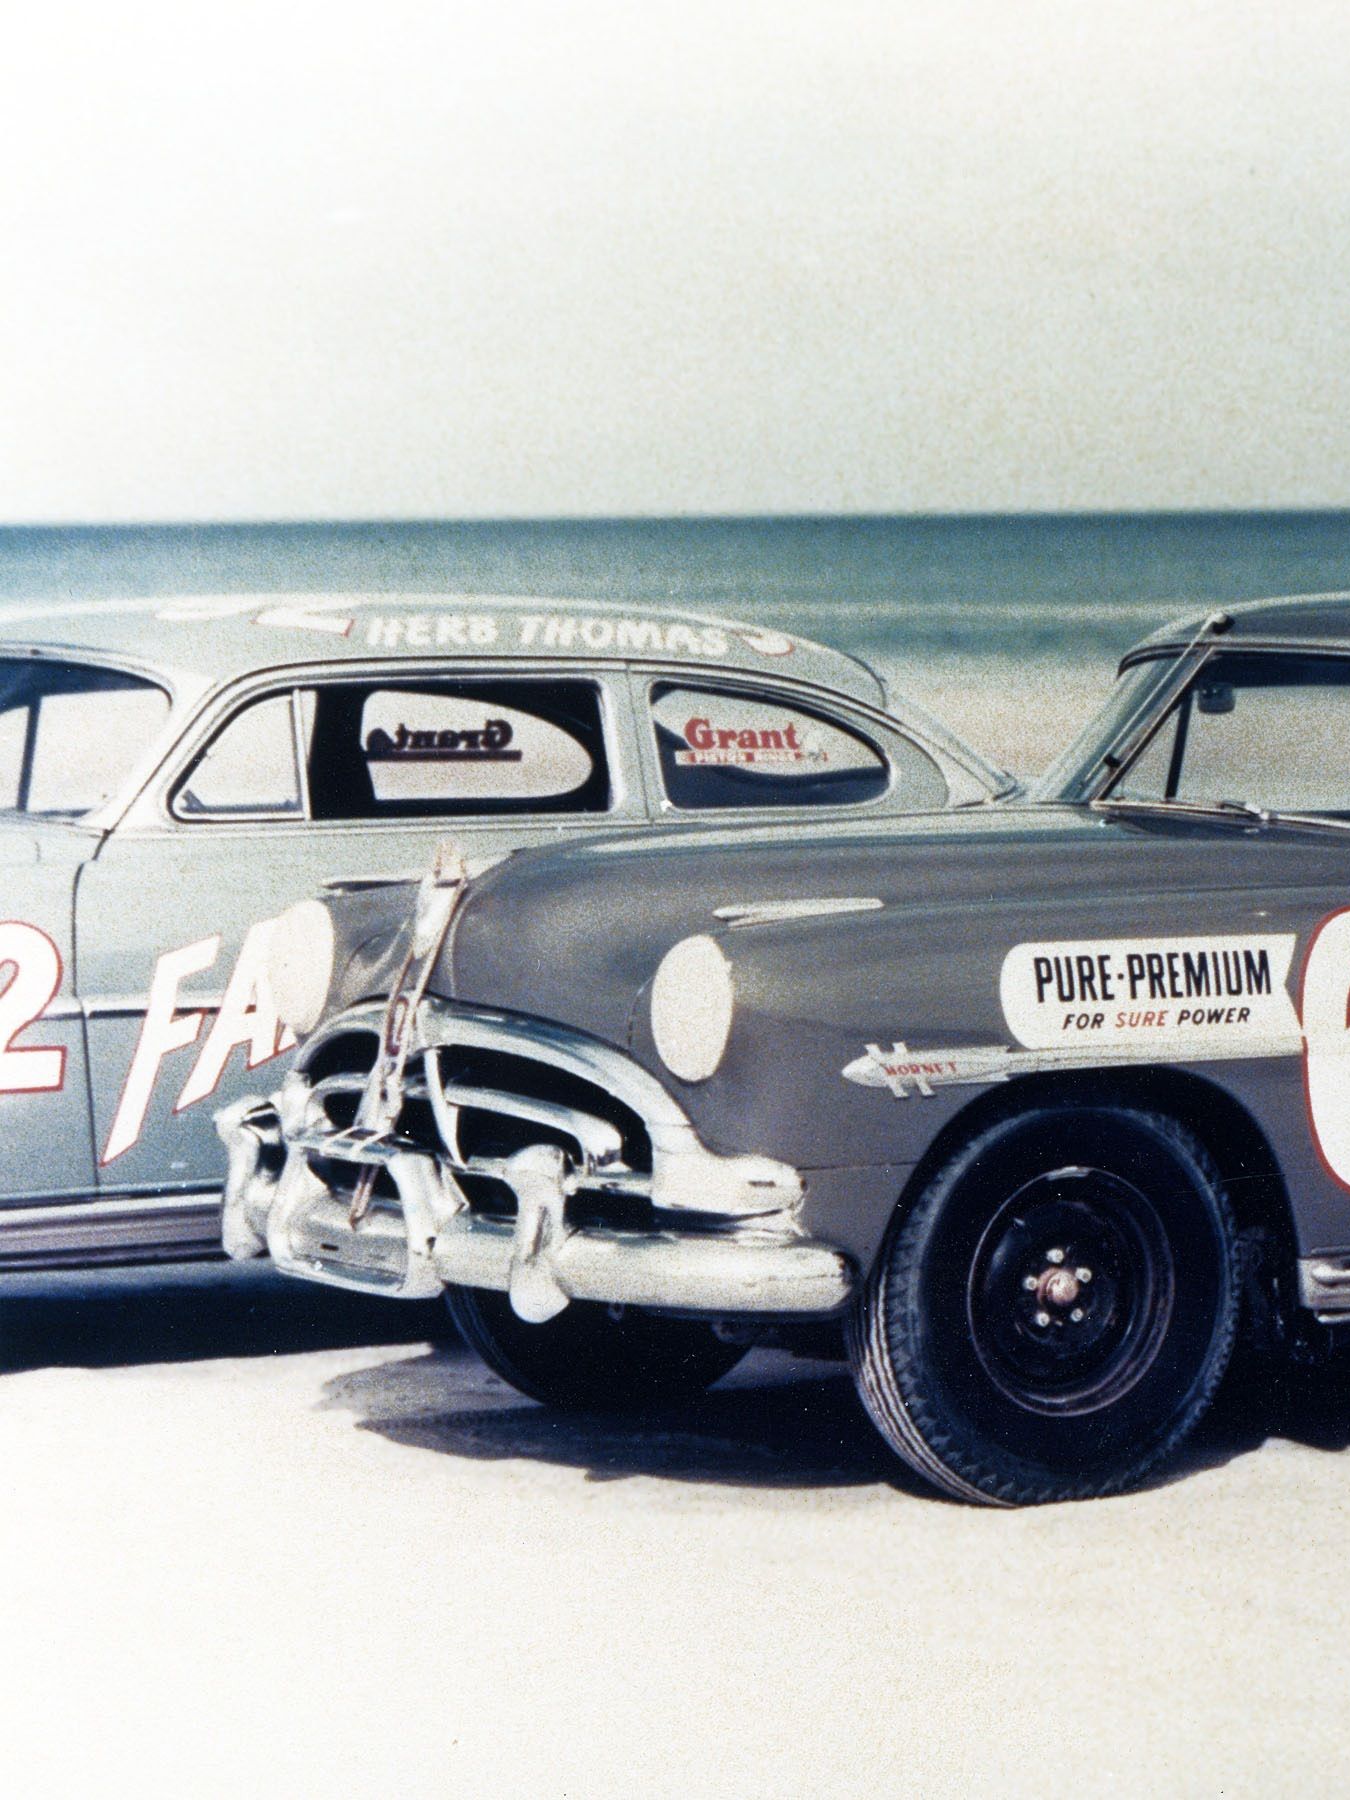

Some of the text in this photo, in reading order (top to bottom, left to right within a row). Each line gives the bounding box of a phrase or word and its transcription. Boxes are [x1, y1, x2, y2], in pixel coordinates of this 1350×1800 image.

[366, 615, 730, 657] HERB THOMAS
[684, 716, 801, 750] Grant
[0, 919, 67, 1094] 2
[1062, 1006, 1252, 1031] FOR SURE POWER
[99, 922, 297, 1167] FA
